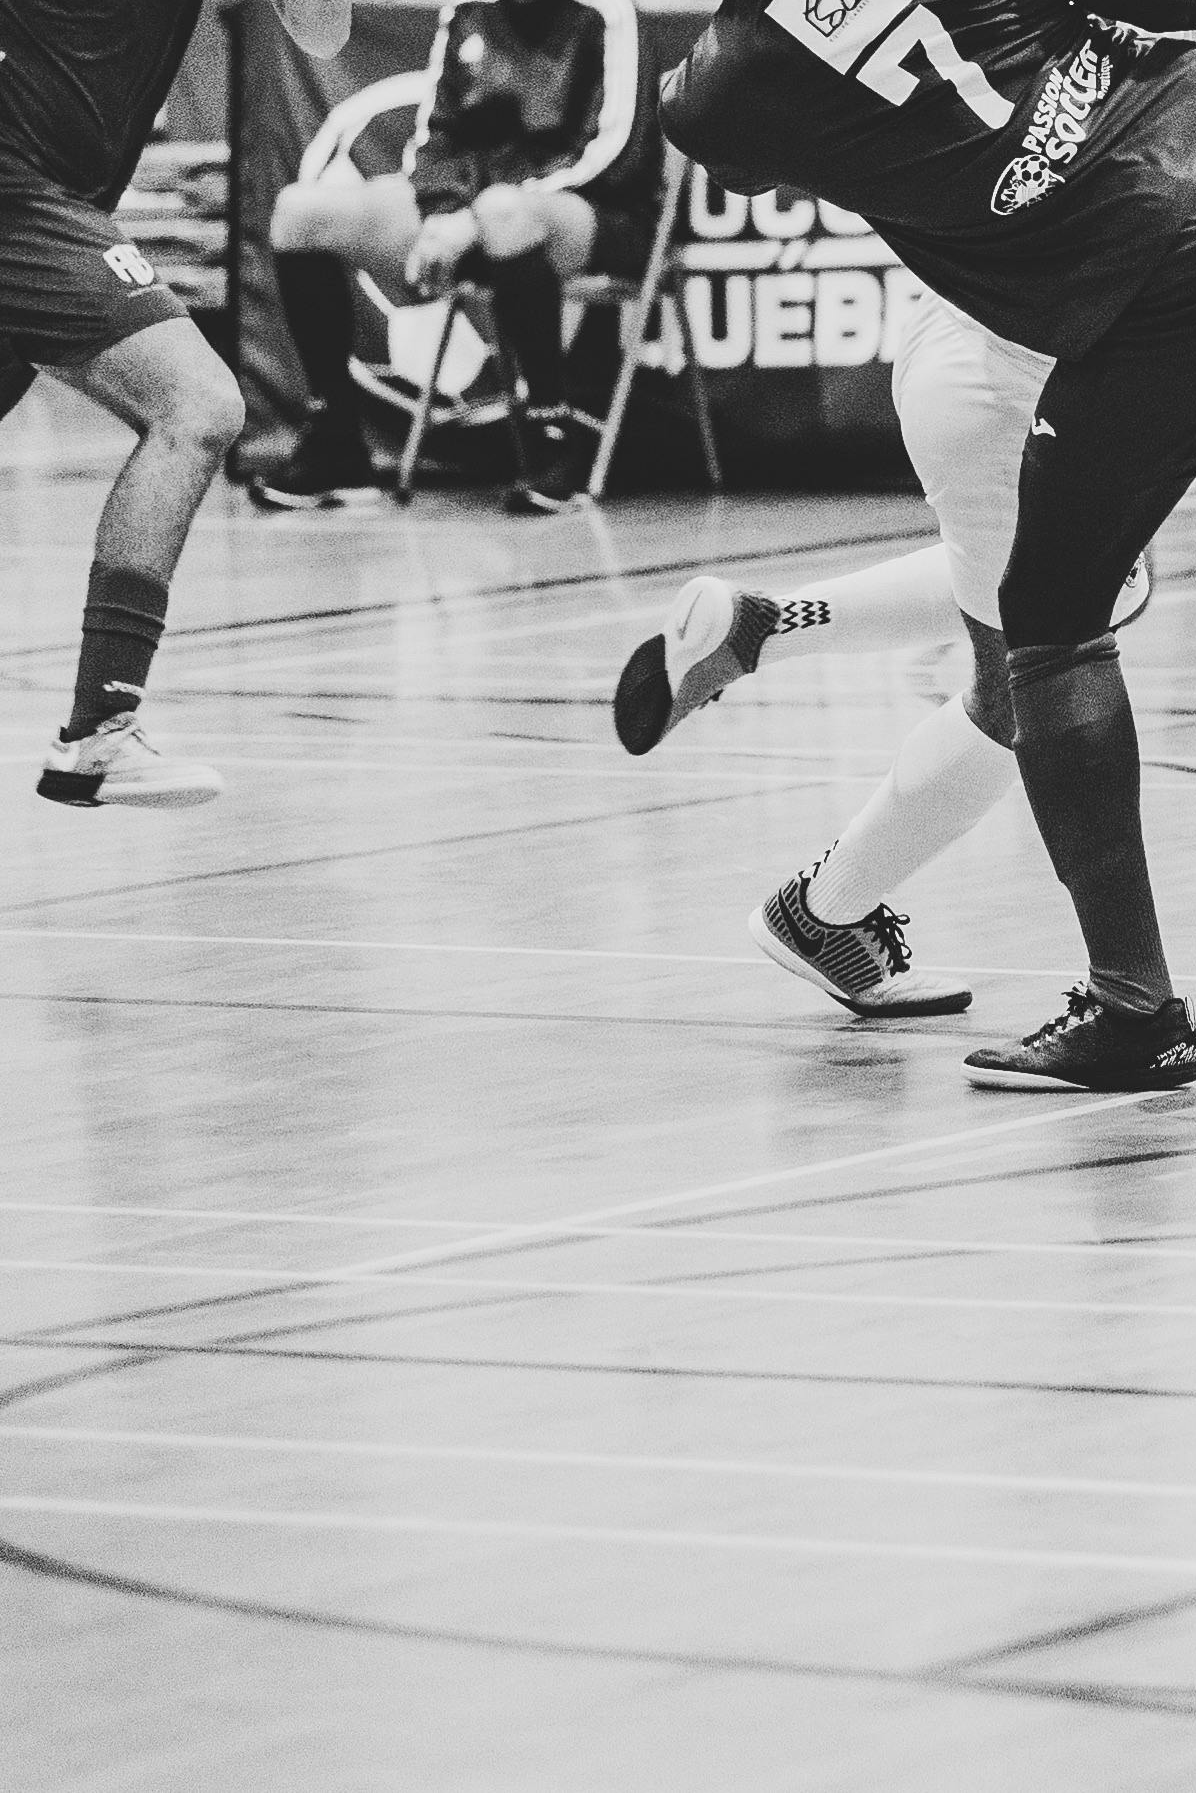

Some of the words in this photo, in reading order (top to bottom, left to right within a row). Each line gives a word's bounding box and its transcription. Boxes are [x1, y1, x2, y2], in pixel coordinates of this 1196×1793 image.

[855, 3, 1016, 130] 7
[1022, 66, 1064, 154] PASSION
[1045, 38, 1099, 164] SOCCER
